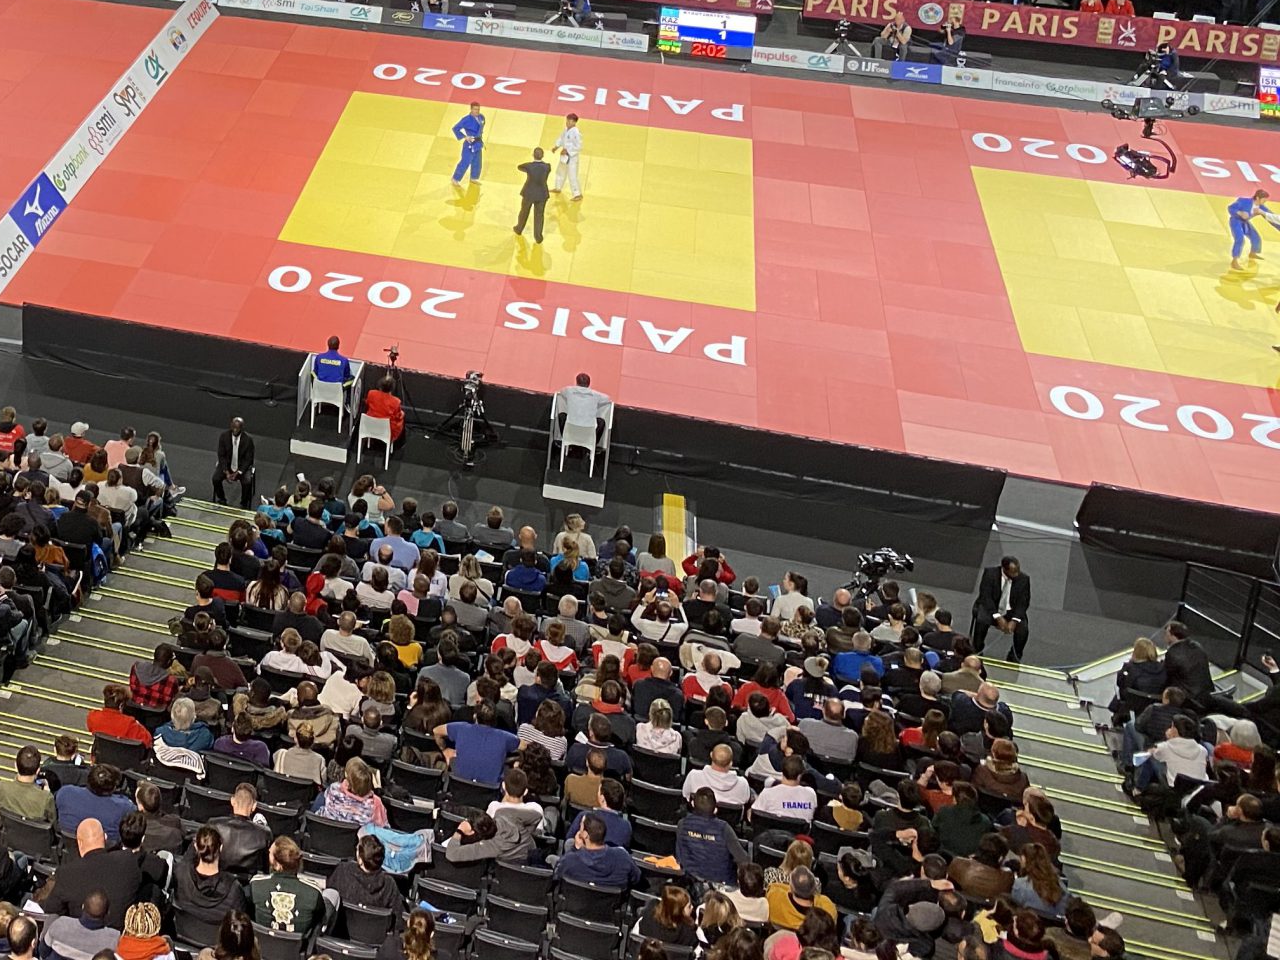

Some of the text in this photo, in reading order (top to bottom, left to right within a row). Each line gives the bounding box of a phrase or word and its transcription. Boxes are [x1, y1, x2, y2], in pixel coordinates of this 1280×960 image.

[300, 3, 339, 14] TaiShan
[474, 19, 499, 34] SMP
[526, 25, 554, 36] TISSOT
[661, 24, 678, 32] ECU
[721, 20, 727, 29] 1
[981, 8, 1080, 39] PARIS
[621, 37, 643, 46] dalkia
[719, 30, 726, 40] 1
[1157, 25, 1260, 57] PARIS
[691, 43, 727, 58] 2:02
[754, 47, 798, 62] impulse
[994, 77, 1040, 90] franceinfo
[1058, 82, 1096, 95] otpbank
[1261, 78, 1277, 86] ISR
[373, 63, 745, 122] PARIS 2020
[112, 84, 142, 118] SMP
[1230, 99, 1255, 111] smi
[96, 105, 117, 137] smi
[63, 143, 89, 181] otpbank
[268, 264, 748, 366] PARIS 2020
[1049, 386, 1280, 450] 2020
[782, 801, 812, 810] FRANCE
